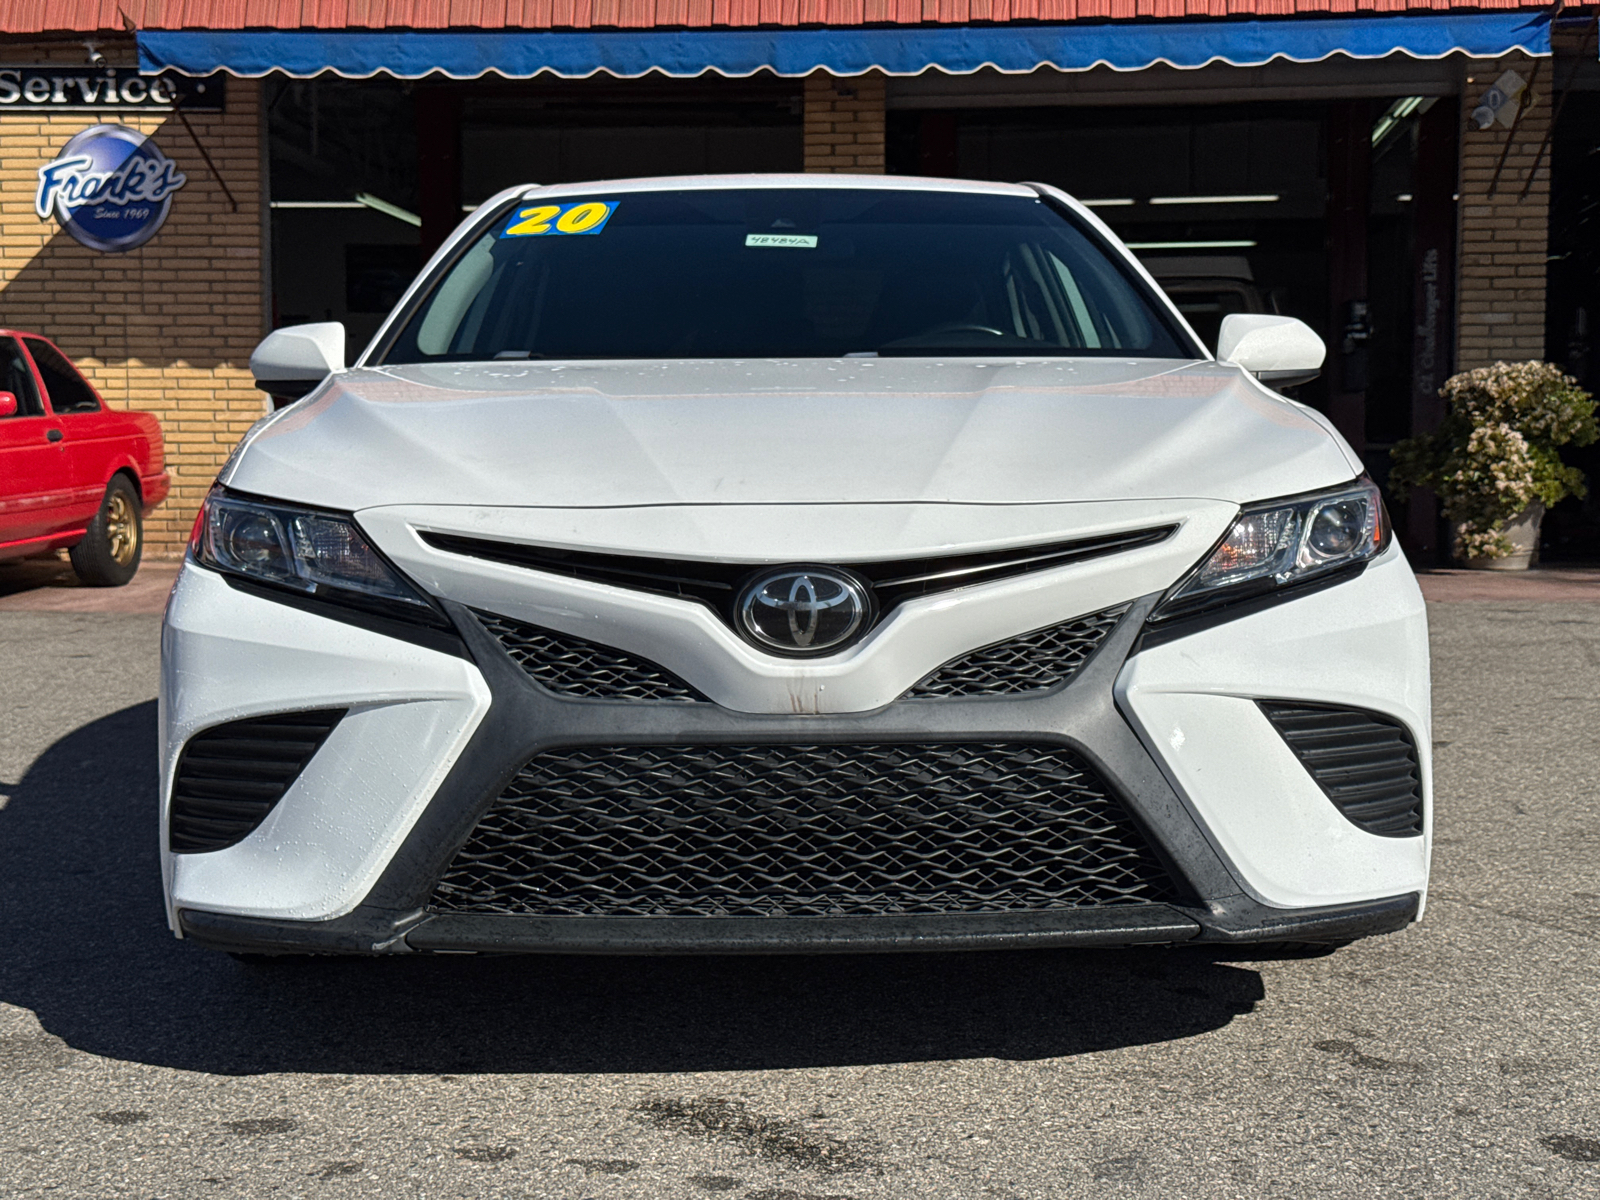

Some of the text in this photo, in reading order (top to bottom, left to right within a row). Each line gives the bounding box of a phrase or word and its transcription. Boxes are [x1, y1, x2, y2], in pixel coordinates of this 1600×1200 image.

[0, 69, 177, 103] Service
[36, 155, 187, 218] Frank's
[94, 207, 150, 219] Since 1969
[506, 202, 610, 234] 20
